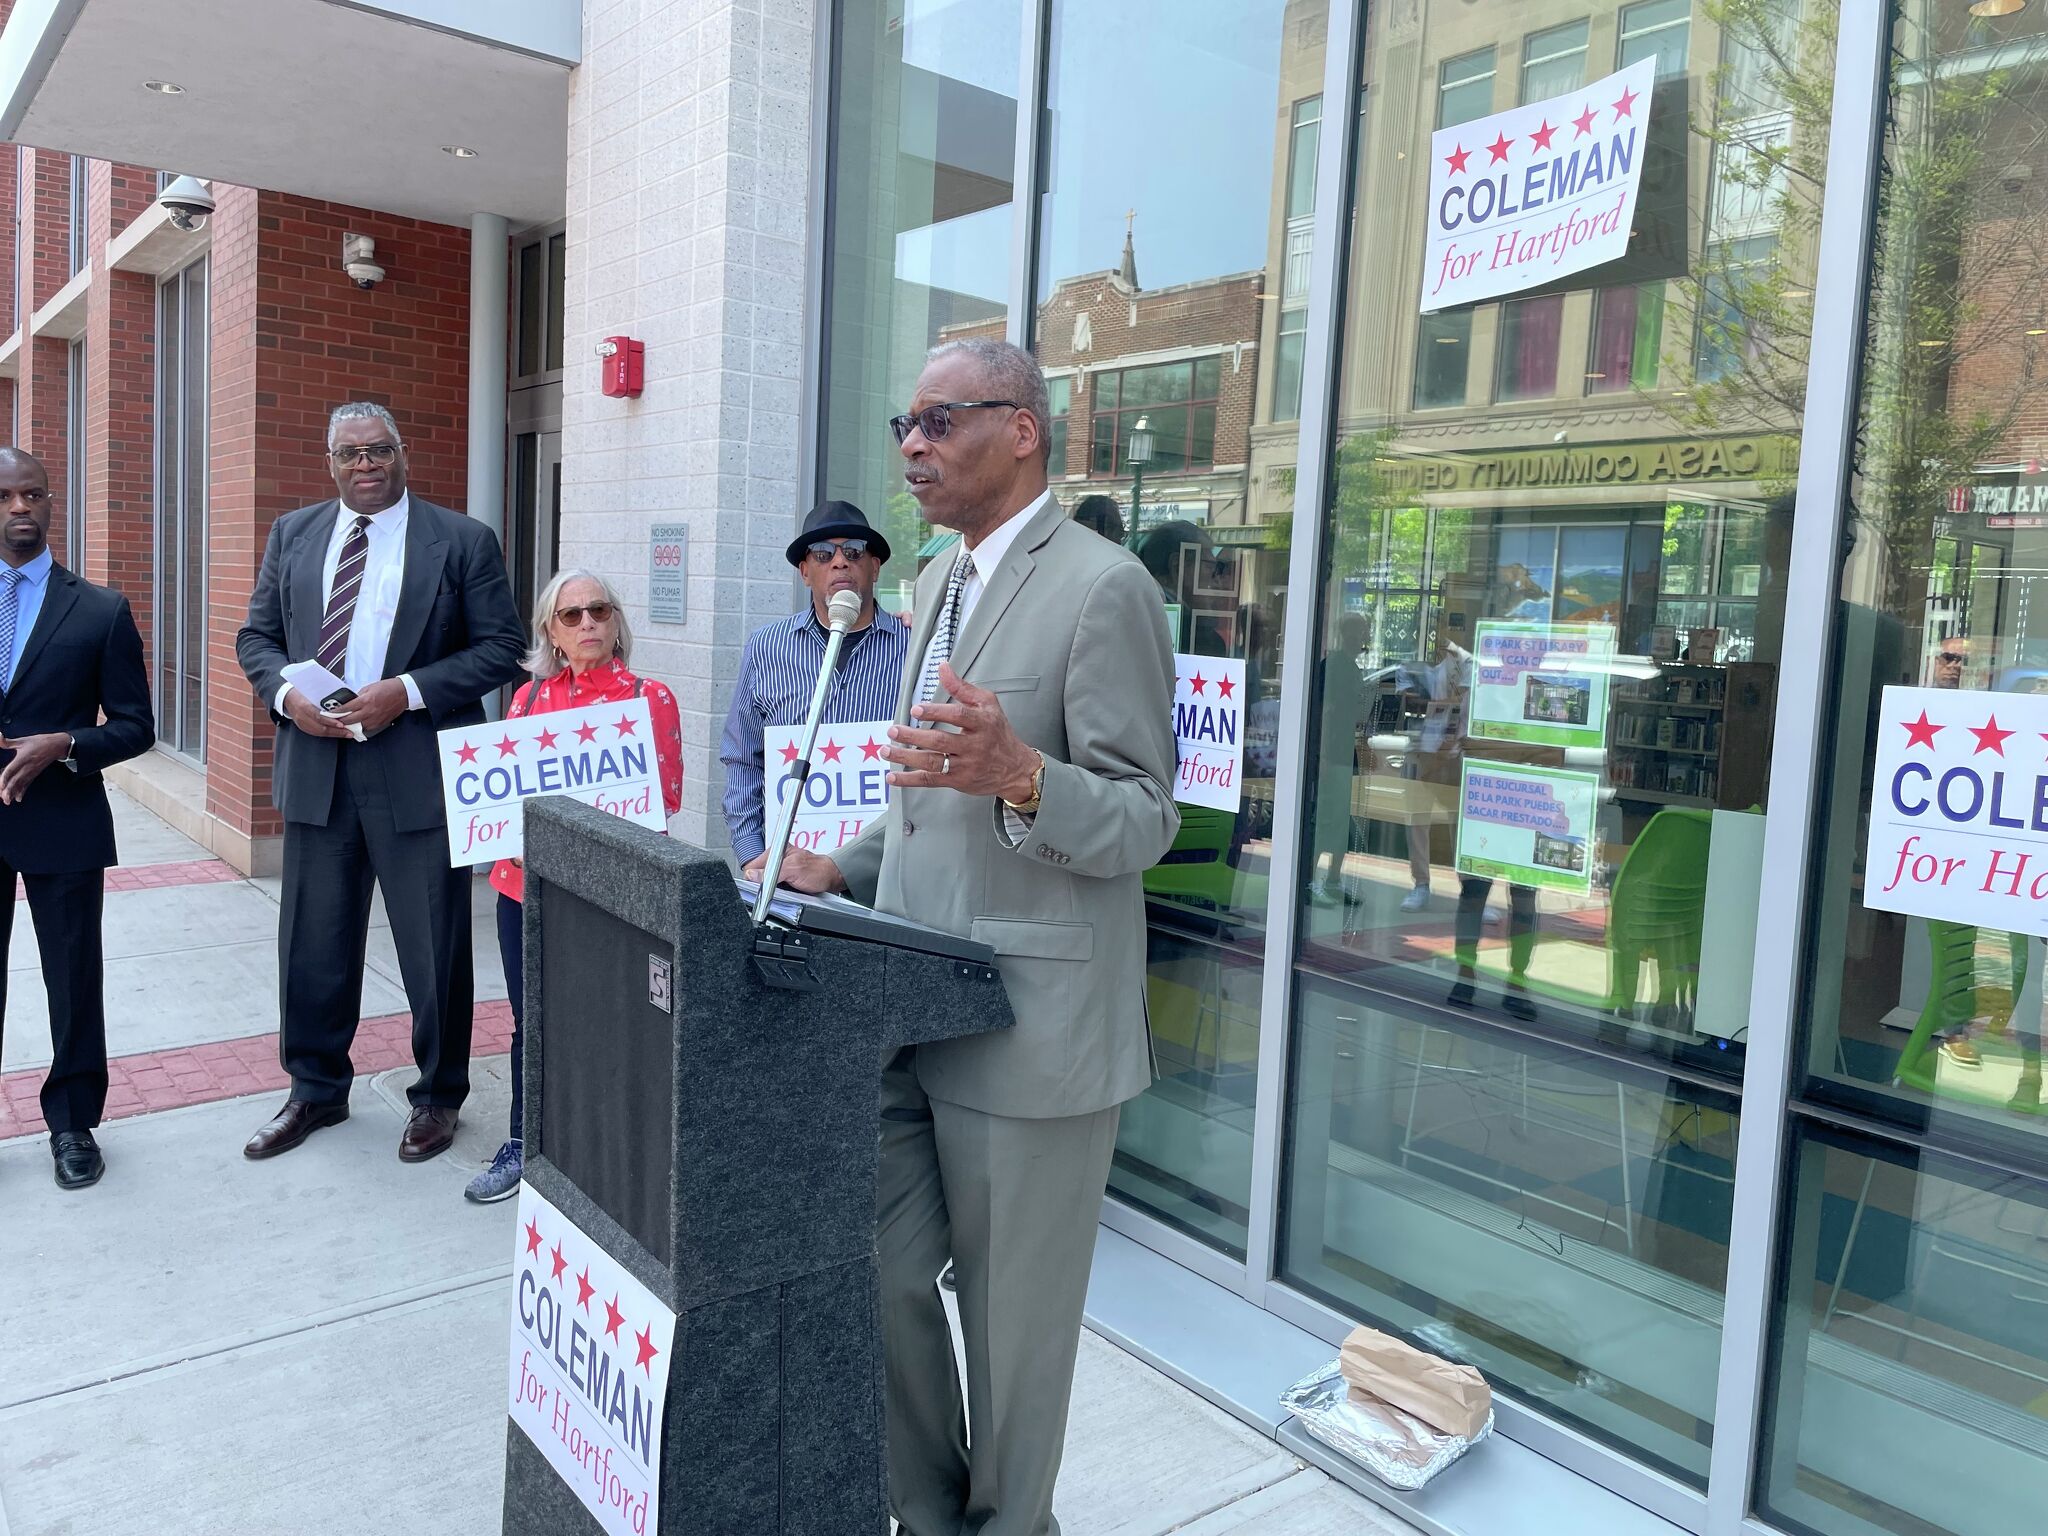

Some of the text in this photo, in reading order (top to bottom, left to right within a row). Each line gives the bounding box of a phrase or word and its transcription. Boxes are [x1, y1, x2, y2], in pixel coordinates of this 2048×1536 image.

[1439, 126, 1637, 231] COLEMAN
[1432, 191, 1627, 295] for Hartford
[651, 527, 685, 538] NO SMOKING
[652, 587, 681, 597] NO FUMAR
[1495, 639, 1520, 650] PARK
[1524, 640, 1537, 651] ST
[1540, 640, 1584, 653] LIBRARY
[1507, 655, 1528, 666] CAN
[1172, 702, 1237, 746] MAN
[455, 742, 648, 805] COLEMAN
[776, 769, 890, 808] COLE
[1178, 752, 1235, 790] tford
[1469, 776, 1546, 796] EN EL SUCURSAL
[1467, 805, 1498, 818] SACAR
[1468, 790, 1561, 813] DE LA PARK PUEDES
[462, 814, 510, 854] for
[789, 819, 827, 850] or
[1882, 835, 1966, 892] for
[518, 1268, 653, 1468] COLEMAN
[515, 1349, 649, 1536] for Hartford
